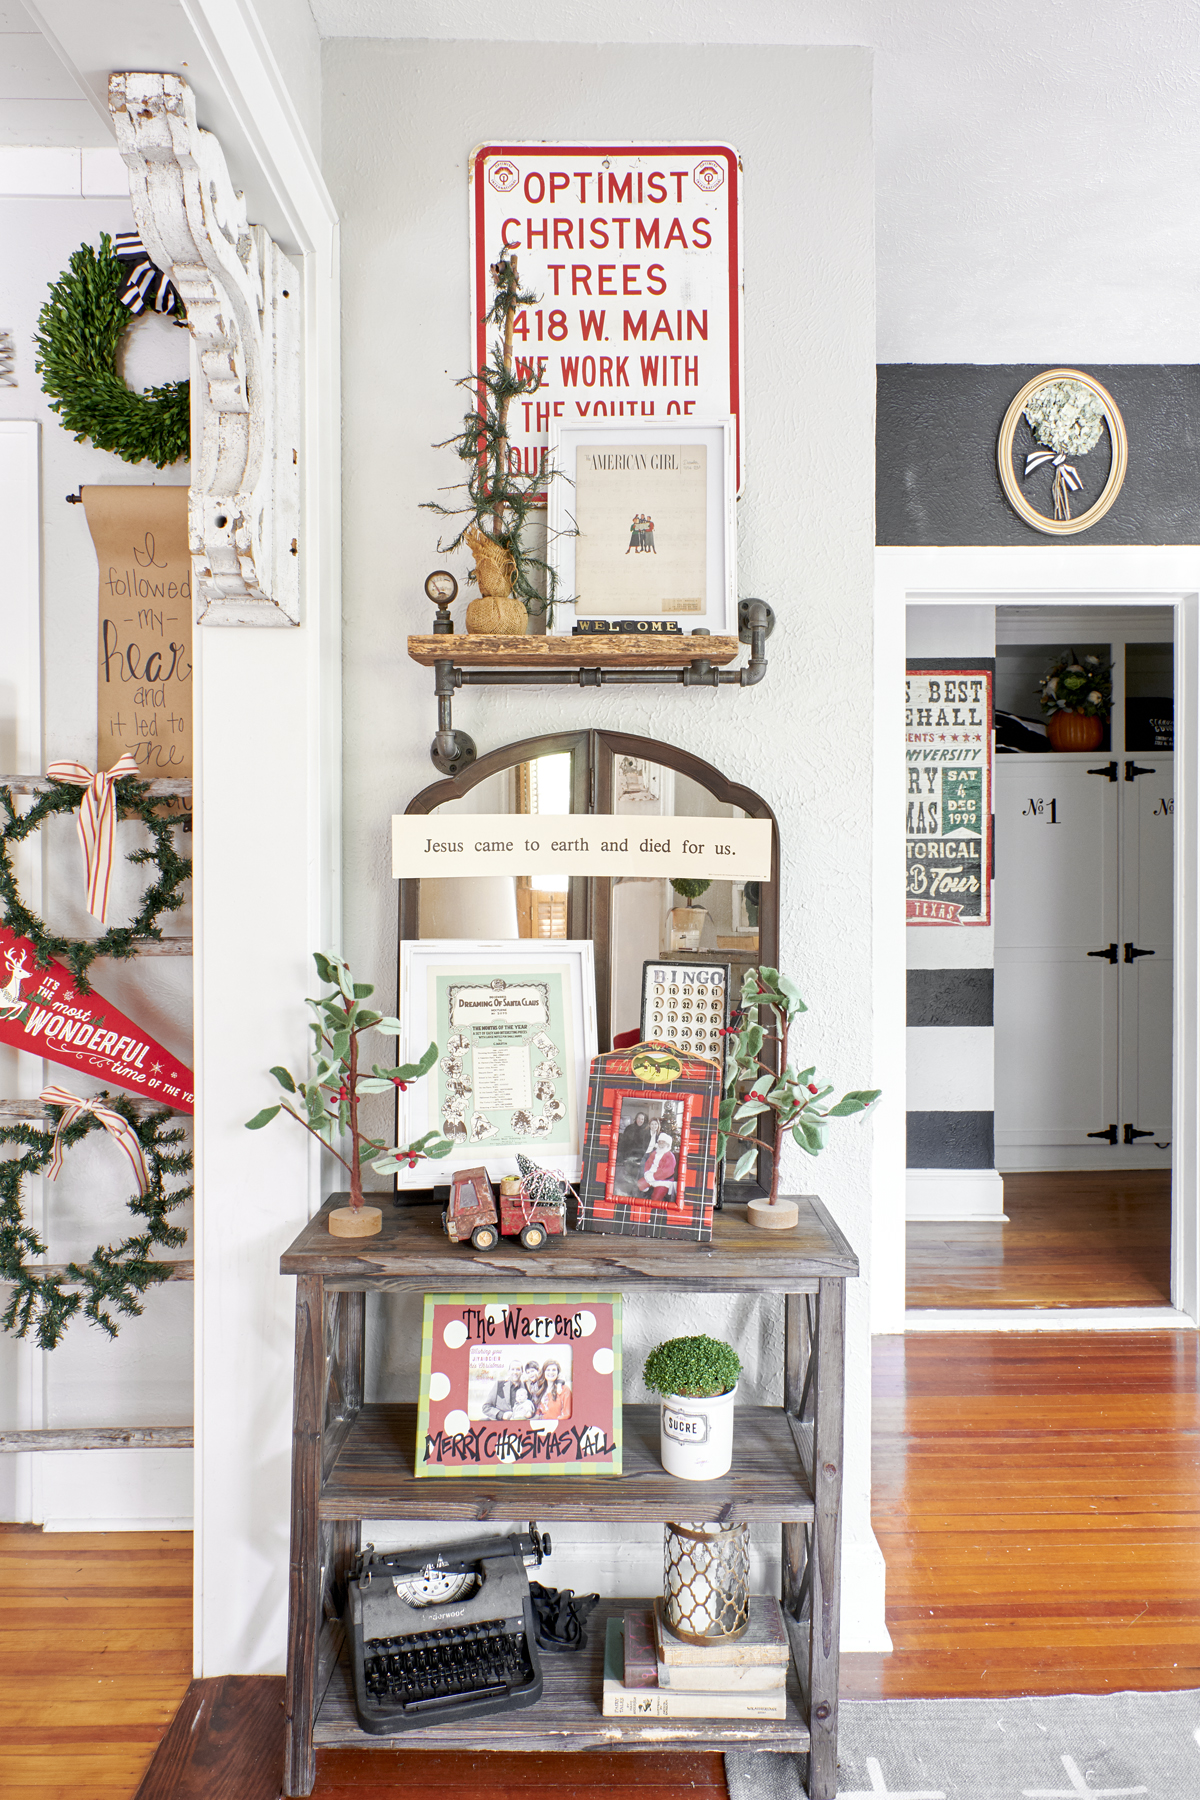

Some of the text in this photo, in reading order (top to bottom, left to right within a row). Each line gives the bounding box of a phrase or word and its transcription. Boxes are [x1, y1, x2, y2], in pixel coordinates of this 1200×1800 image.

[523, 171, 689, 204] OPTIMIST
[501, 217, 712, 249] CHRISTMAS
[547, 264, 667, 296] TREES
[512, 309, 708, 341] 418 W. MAIN
[514, 355, 698, 388] WE WORK WITH
[590, 454, 647, 470] AMERICAN
[650, 454, 679, 470] GIRL
[133, 531, 168, 568] I
[105, 566, 192, 600] followed
[579, 620, 677, 632] WELCOME
[134, 683, 166, 708] and
[928, 680, 982, 702] BEST
[110, 712, 184, 737] it led to
[906, 733, 934, 742] ENTS
[948, 770, 978, 781] SAT
[957, 784, 966, 798] 4
[948, 800, 976, 811] DEC
[948, 813, 977, 825] 1999
[424, 838, 736, 856] Jesus came to earth and died for us.
[906, 864, 980, 897] B Tour
[914, 902, 955, 919] TEXAS
[42, 976, 60, 990] IT'S
[654, 970, 723, 986] BINGO
[36, 986, 55, 1000] THE
[458, 998, 539, 1008] DREAMING OF SANTA CLAUS
[52, 1000, 92, 1022] most
[711, 1002, 718, 1010] 62
[24, 1006, 150, 1068] WONDERFUL
[111, 1061, 146, 1083] time
[148, 1078, 162, 1088] OF
[162, 1083, 181, 1097] THE
[462, 1307, 582, 1344] The Warrens
[668, 1416, 697, 1434] SUCRE
[423, 1426, 486, 1462] MERRY
